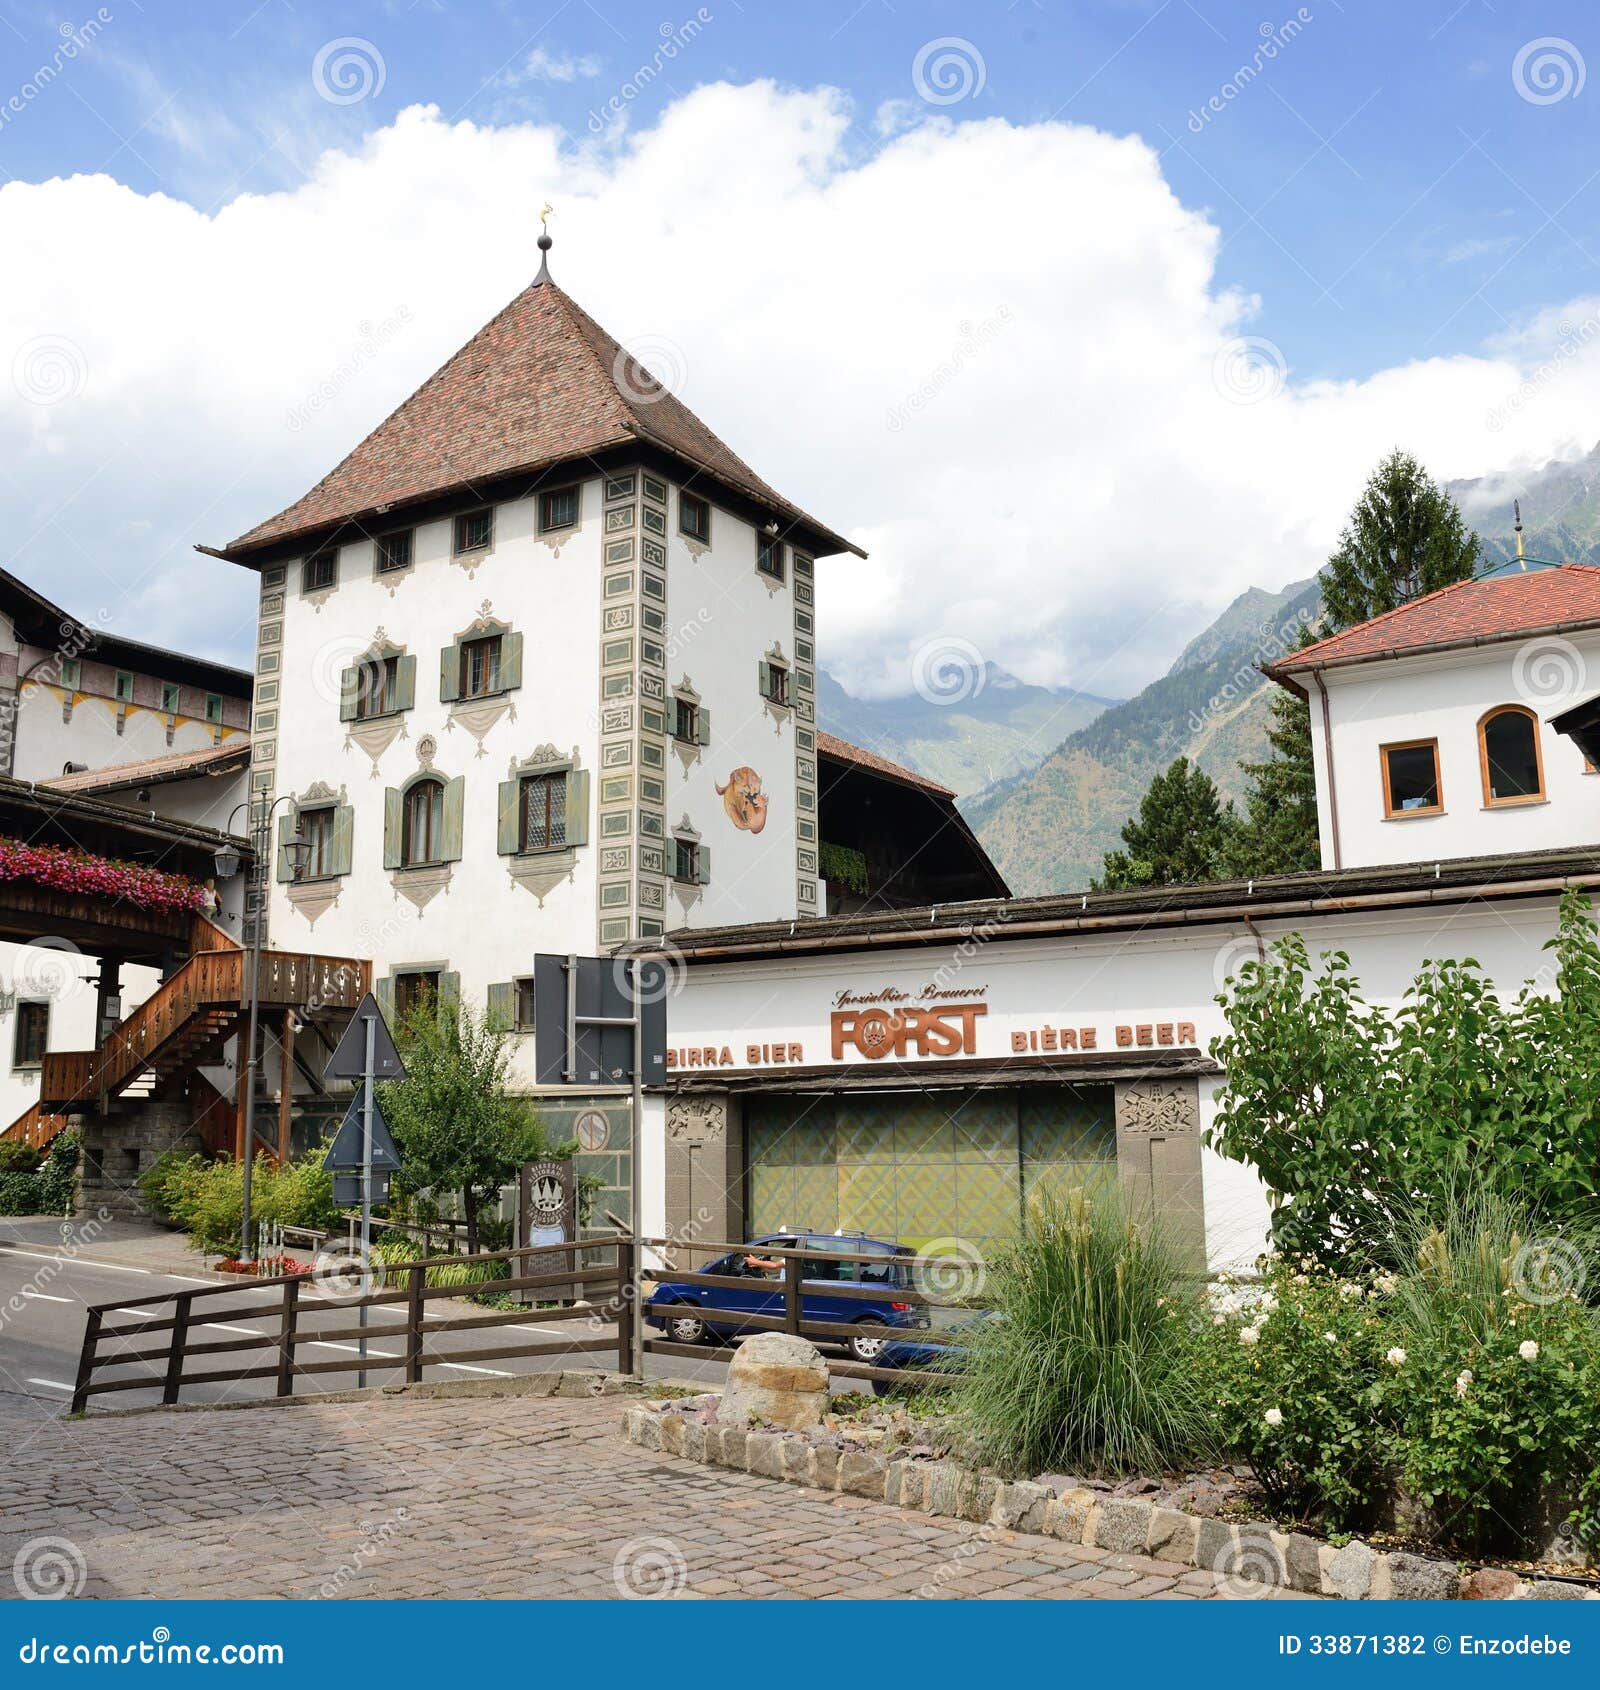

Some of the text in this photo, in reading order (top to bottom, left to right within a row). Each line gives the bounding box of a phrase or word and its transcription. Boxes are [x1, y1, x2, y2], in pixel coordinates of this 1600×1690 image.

[915, 984, 988, 1001] Brauerei
[831, 1003, 987, 1059] FORST
[1011, 1022, 1196, 1052] BIÈRE BEER
[667, 1046, 734, 1067] BIRRA
[746, 1043, 803, 1064] BIER
